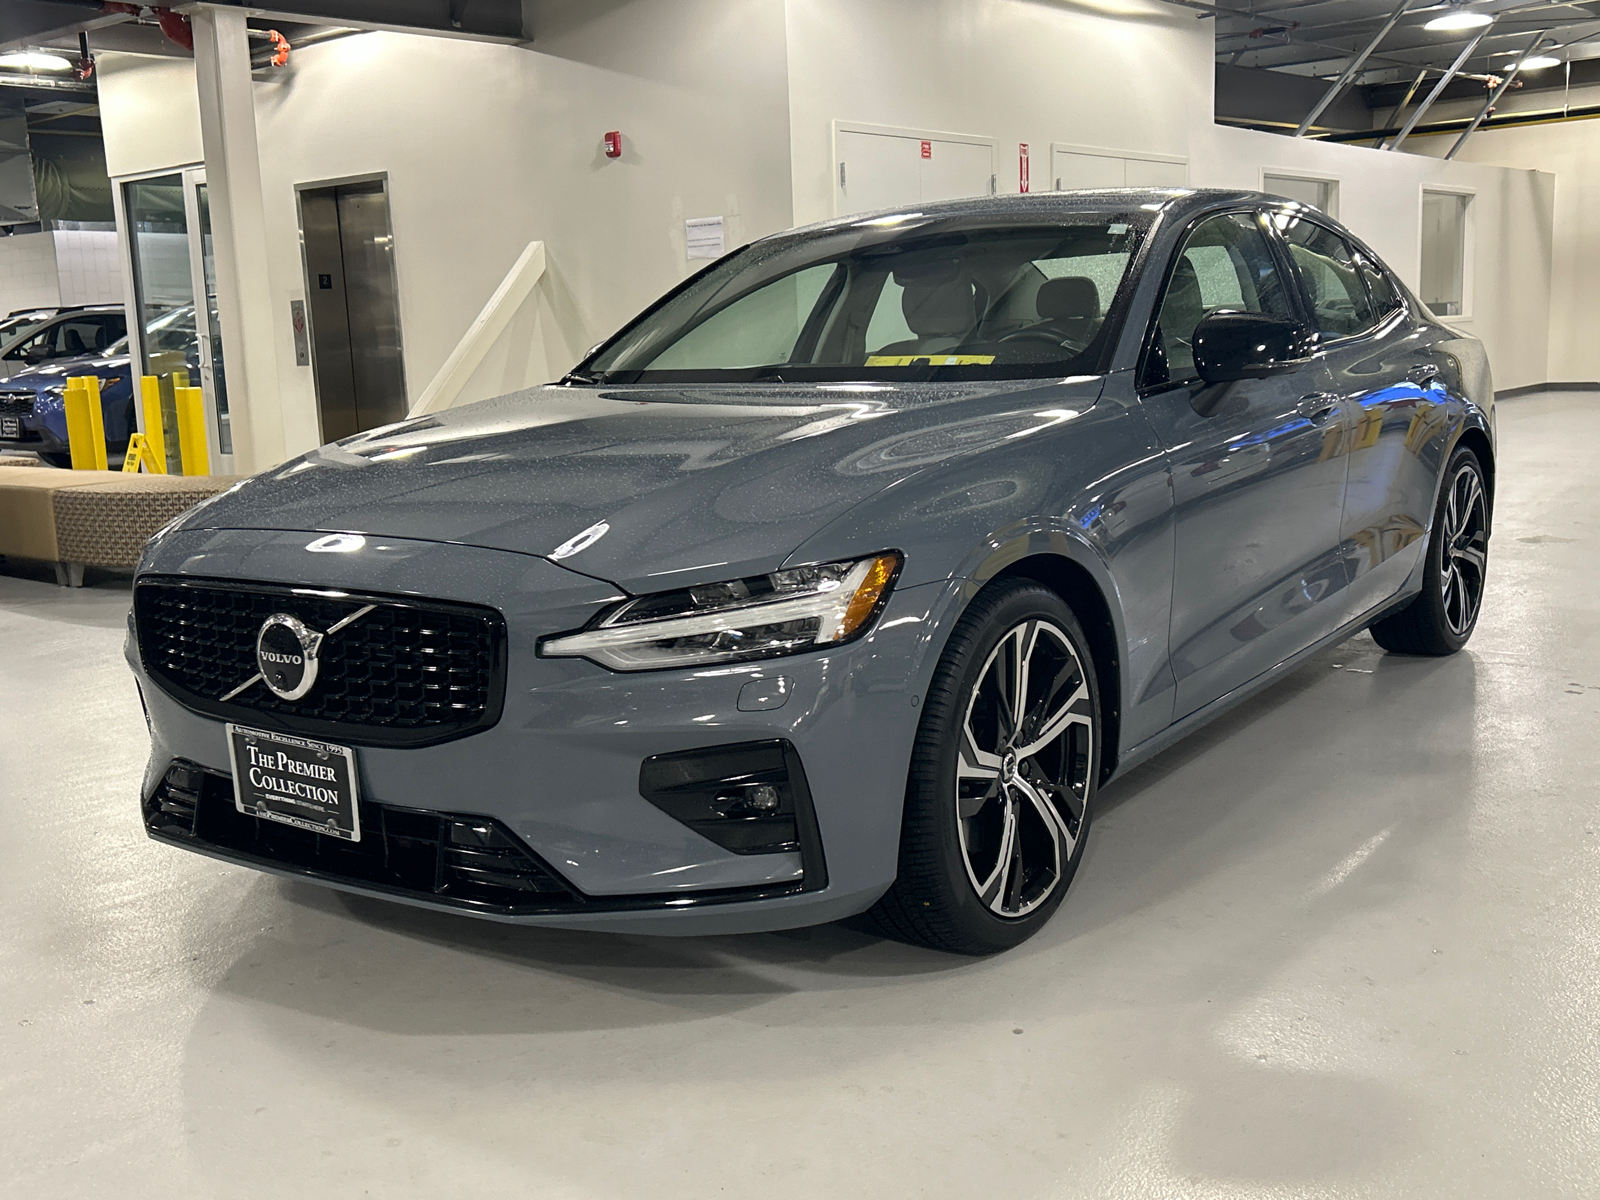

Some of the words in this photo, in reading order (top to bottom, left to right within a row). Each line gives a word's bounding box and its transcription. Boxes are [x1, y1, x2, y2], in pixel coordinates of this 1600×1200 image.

[260, 651, 302, 665] VOLVO
[271, 733, 305, 746] EXCELLENCE
[306, 740, 324, 751] SINCE
[246, 745, 276, 770] THE
[276, 751, 337, 782] PREMIER
[249, 767, 339, 805] COLLECTION
